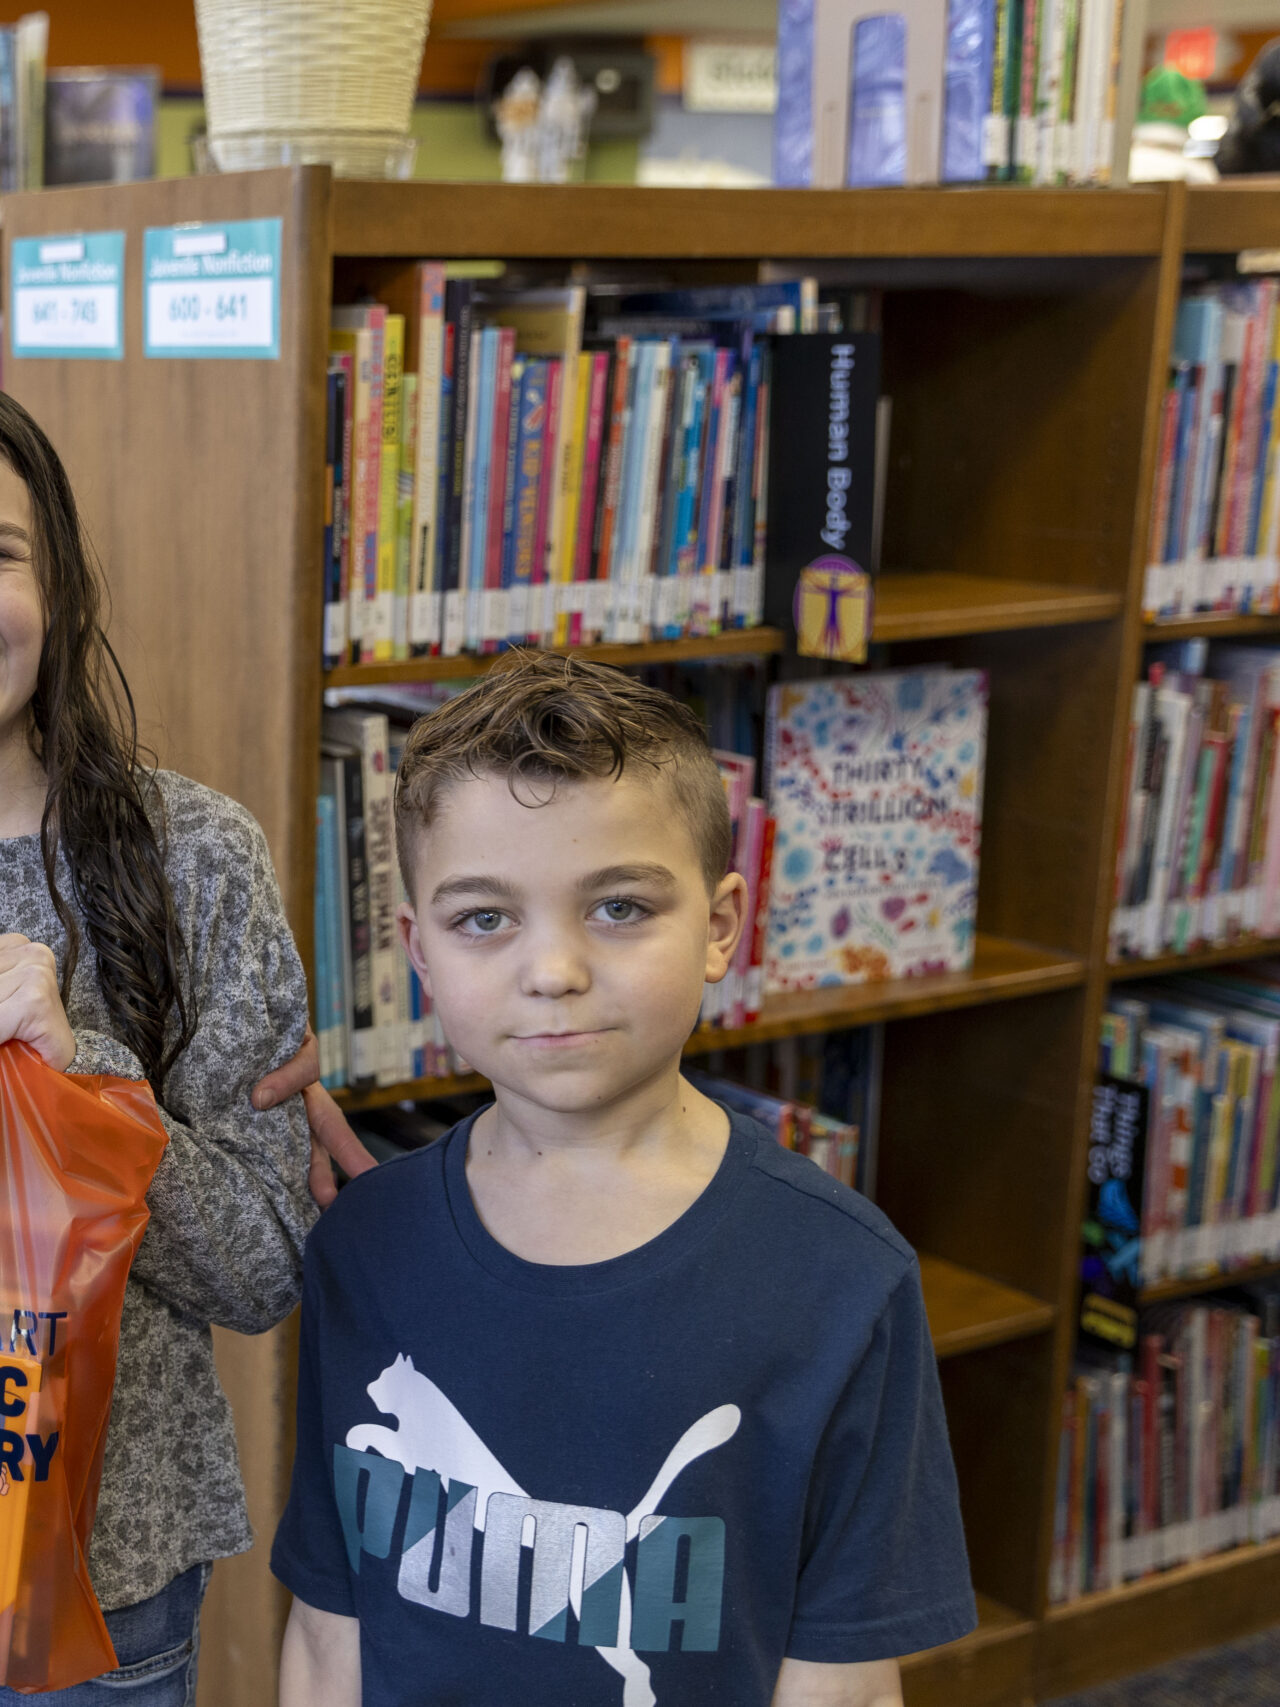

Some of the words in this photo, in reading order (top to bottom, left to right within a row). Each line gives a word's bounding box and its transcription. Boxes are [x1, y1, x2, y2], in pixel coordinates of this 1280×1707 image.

[202, 247, 273, 275] Nonfiction
[169, 293, 200, 322] 600
[215, 291, 247, 322] 641
[828, 344, 856, 462] Human
[820, 466, 852, 551] Body
[833, 755, 924, 786] THIRTY
[829, 796, 949, 827] TRILLION
[825, 844, 907, 874] CELLS
[333, 1442, 726, 1653] PUMA
